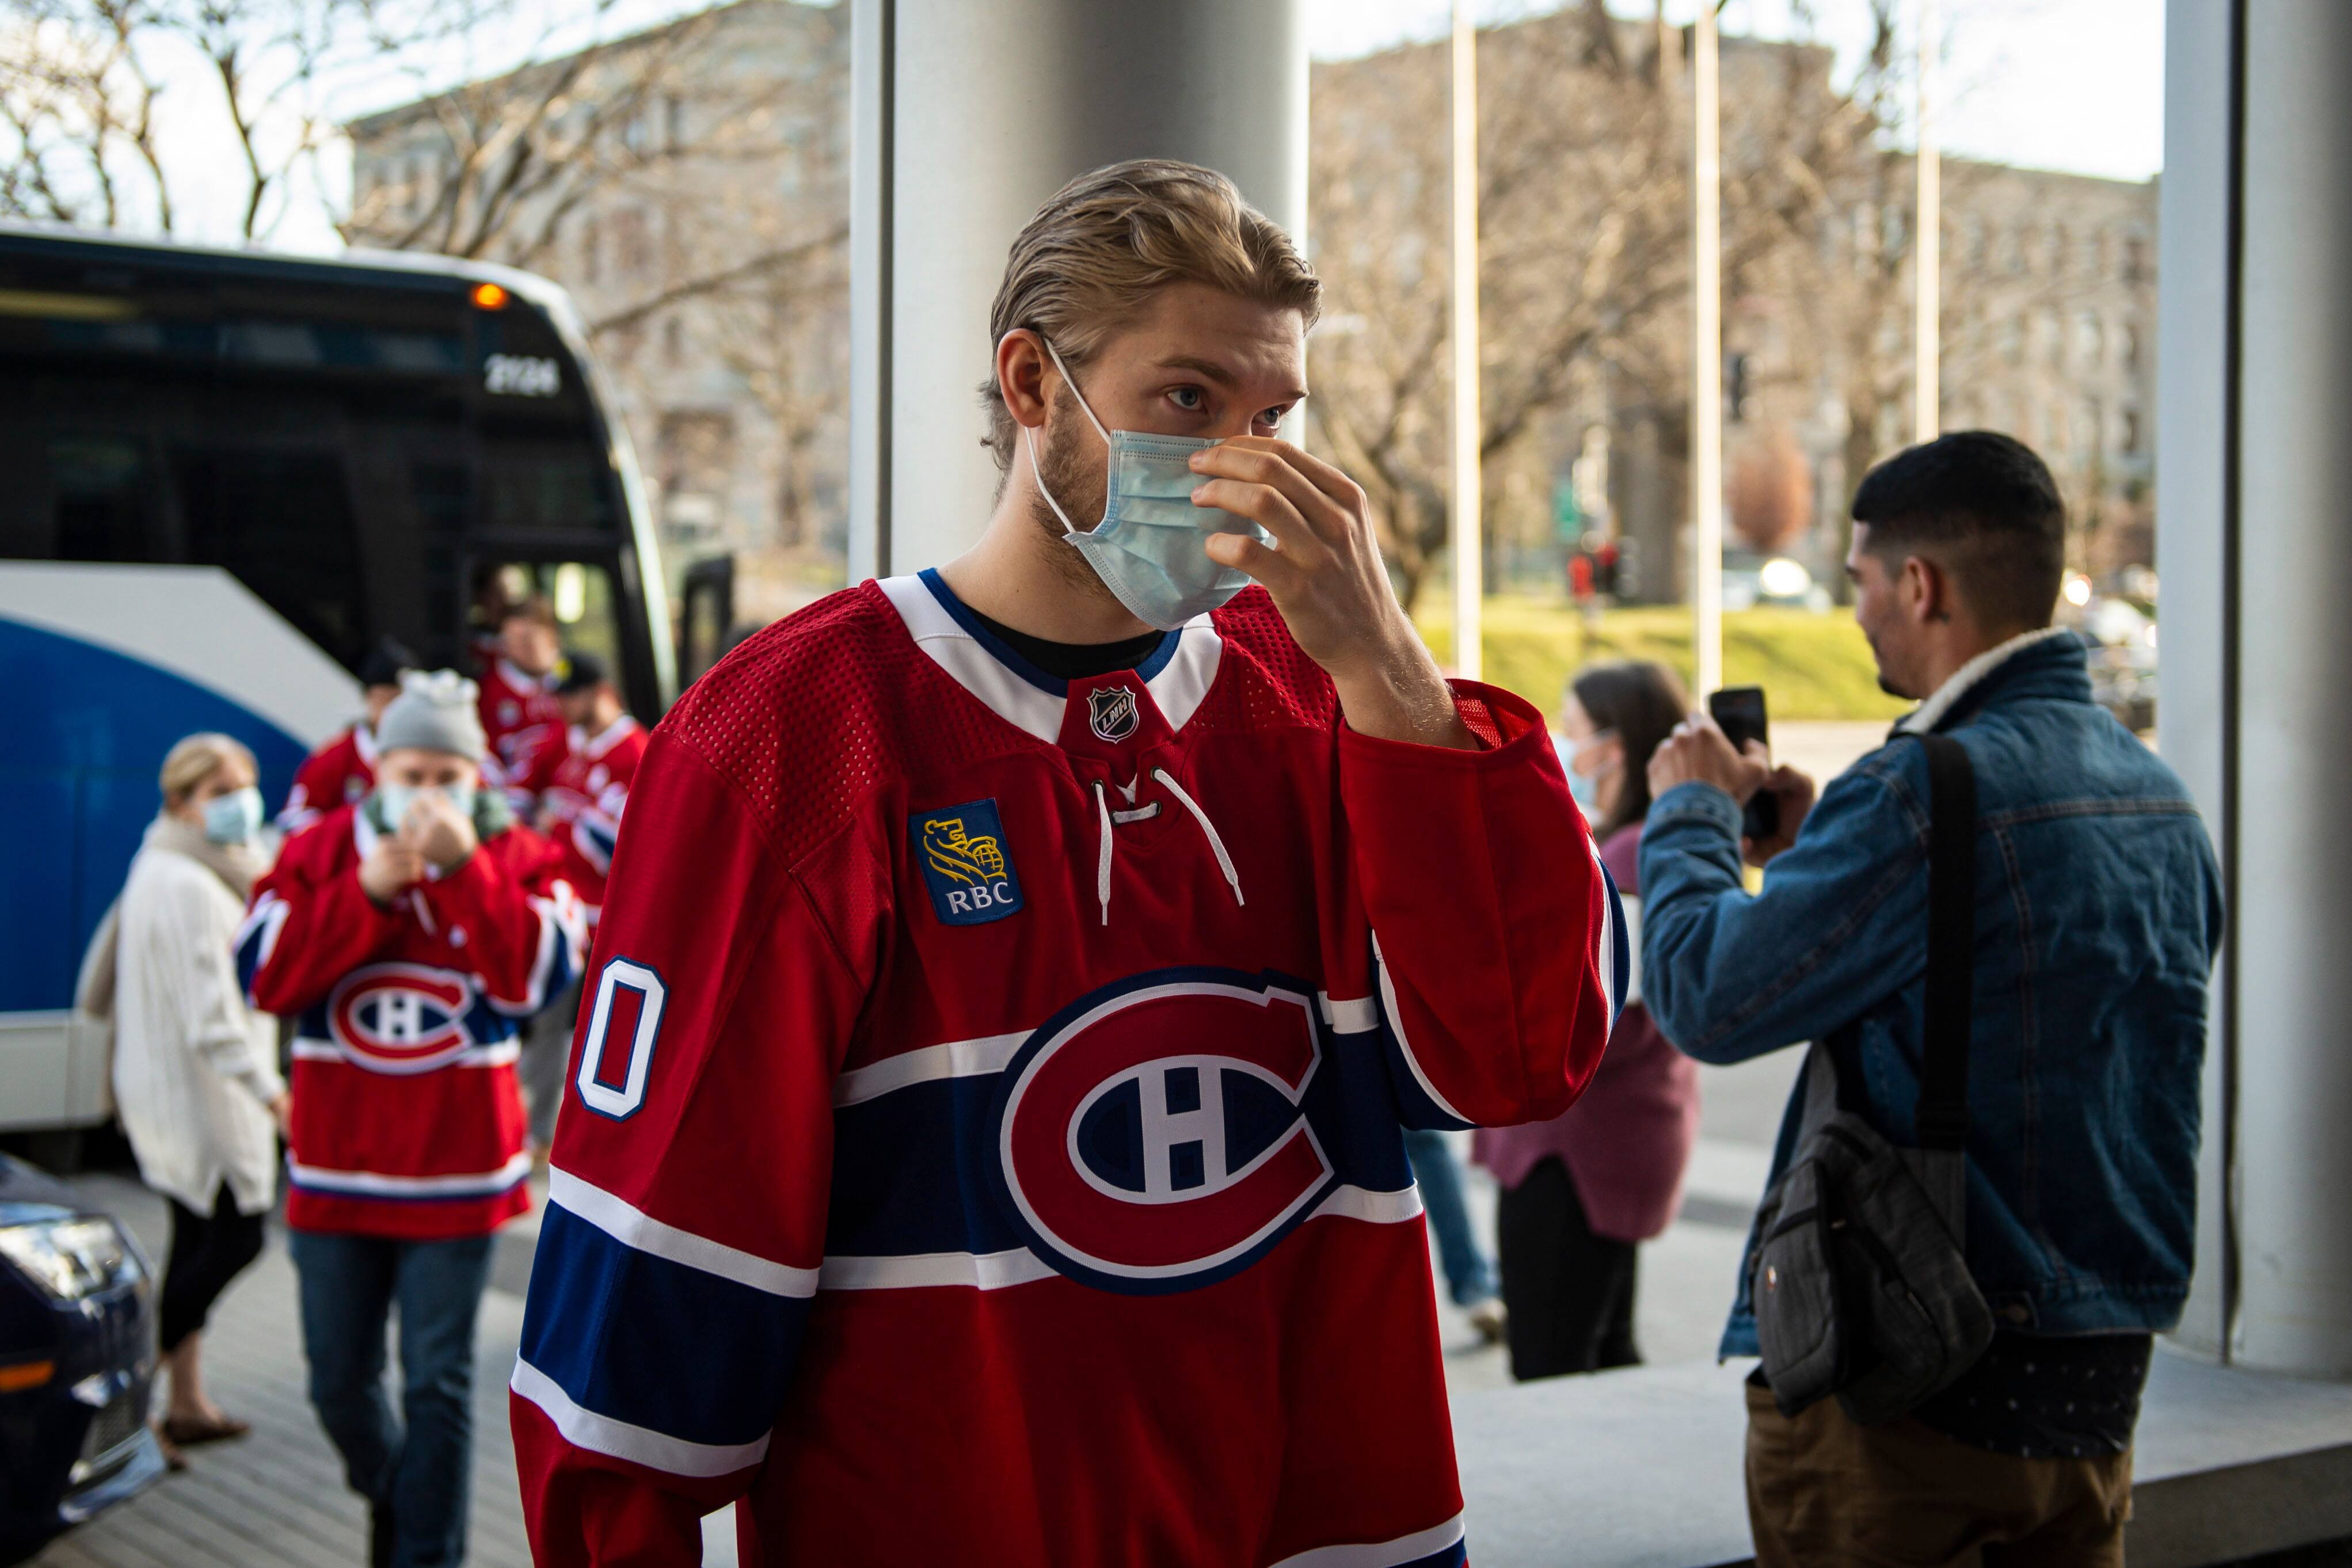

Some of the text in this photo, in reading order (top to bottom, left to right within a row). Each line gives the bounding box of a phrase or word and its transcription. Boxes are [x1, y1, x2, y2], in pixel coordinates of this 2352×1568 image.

[1102, 698, 1127, 731] LNH
[946, 882, 1013, 914] RBC
[575, 954, 668, 1122] 0
